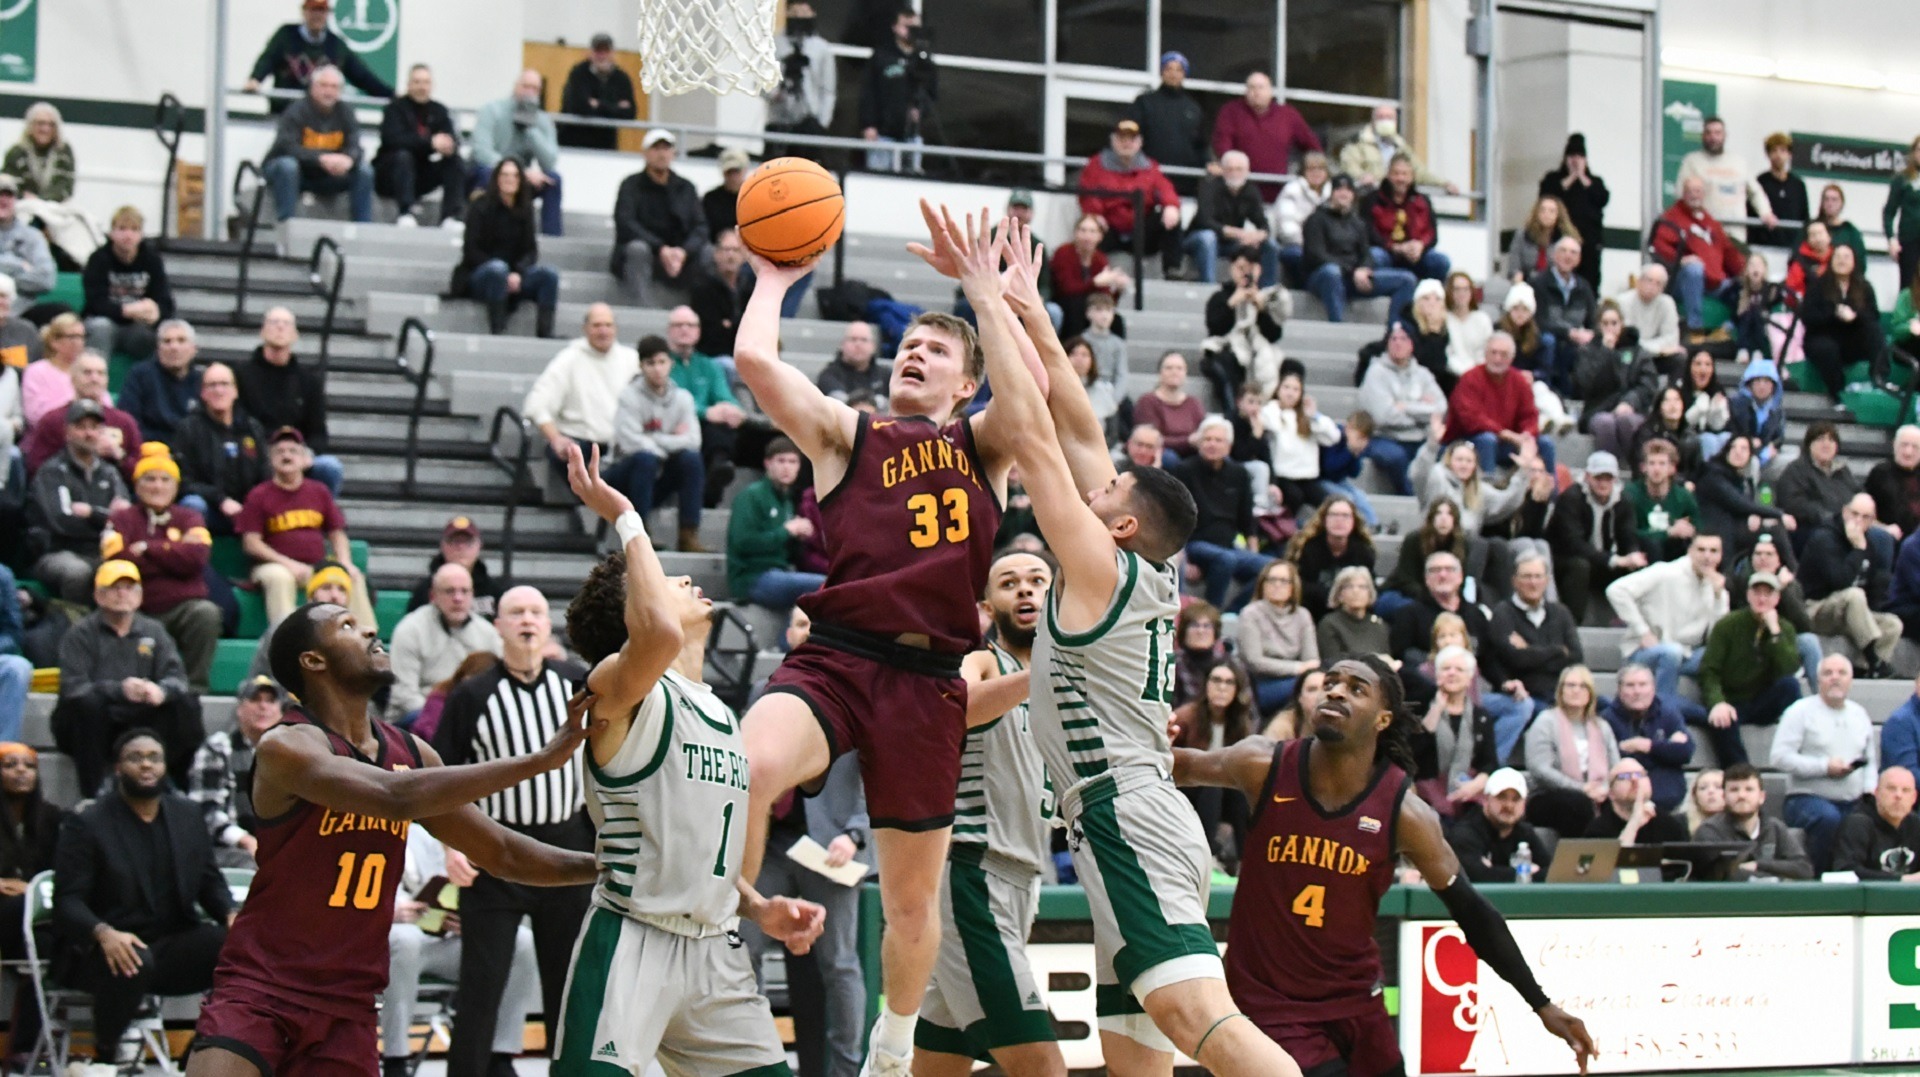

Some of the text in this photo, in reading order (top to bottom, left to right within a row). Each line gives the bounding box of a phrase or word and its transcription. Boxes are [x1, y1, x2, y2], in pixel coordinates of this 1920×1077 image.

[907, 487, 970, 548] 33
[682, 742, 749, 791] THE RO
[713, 801, 733, 877] 1
[1267, 834, 1370, 875] GANNON
[328, 852, 387, 910] 10
[1292, 884, 1326, 928] 4
